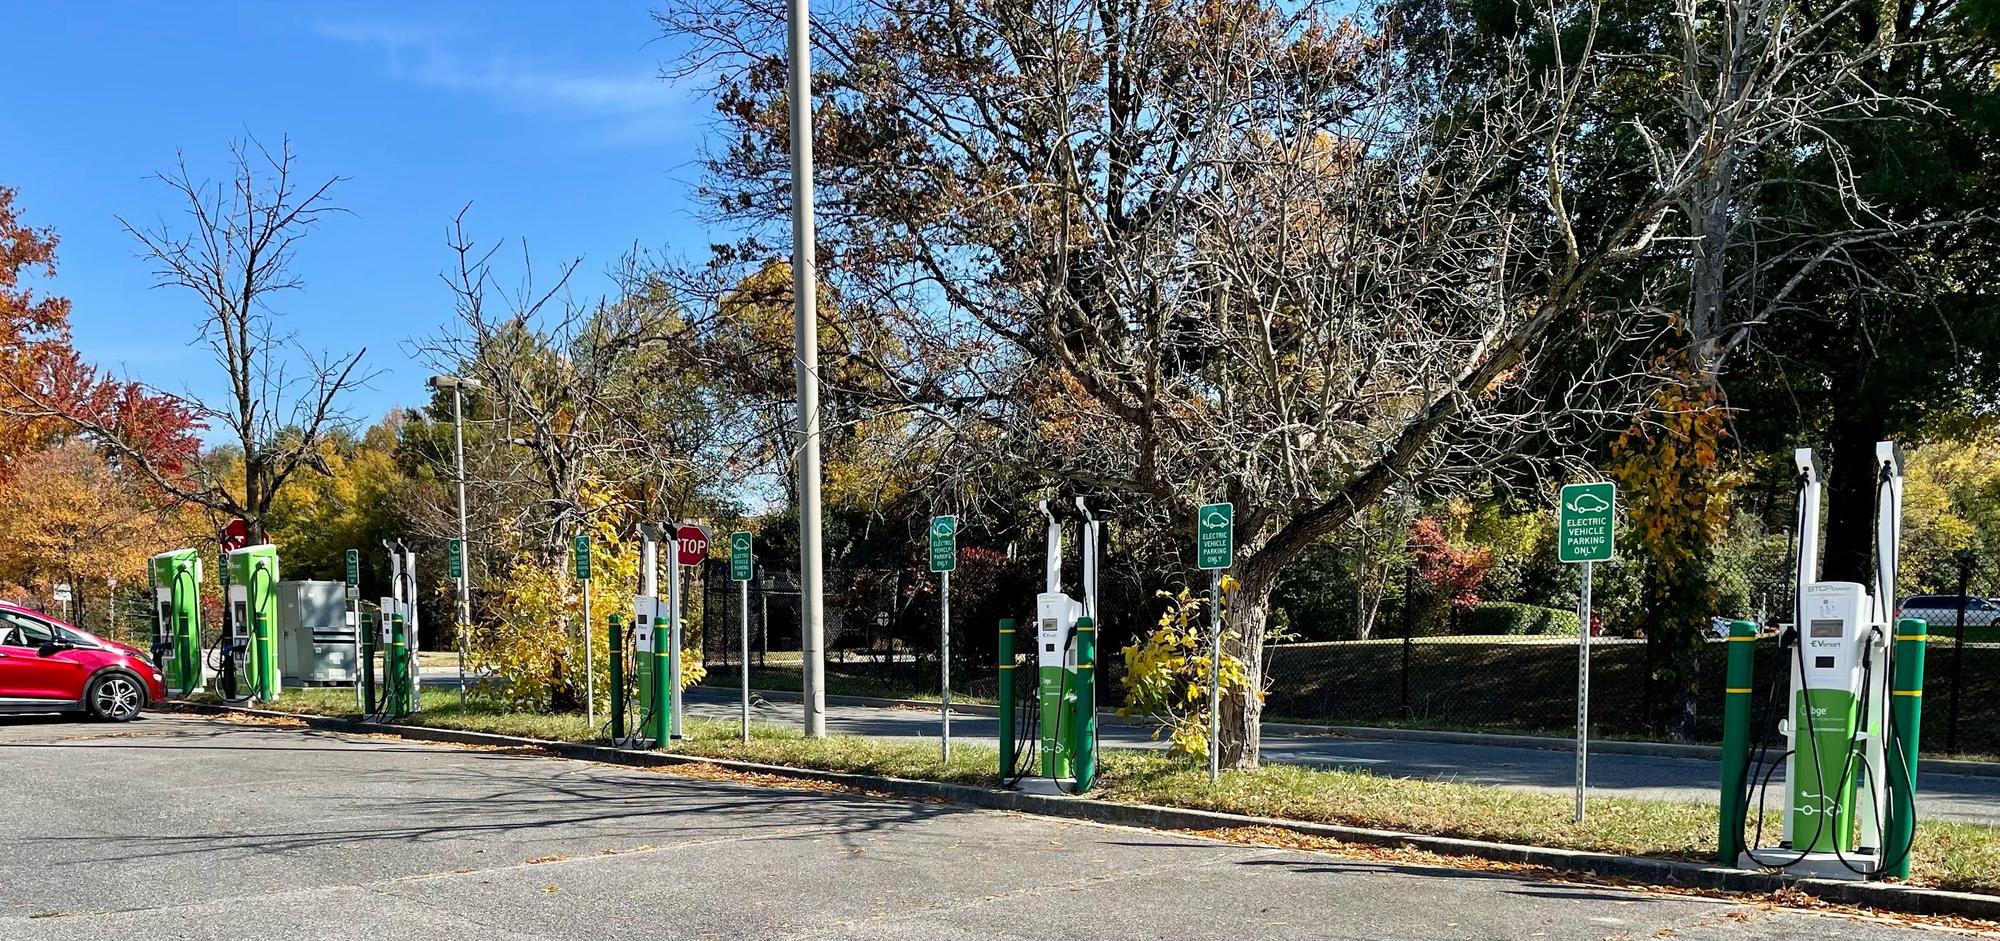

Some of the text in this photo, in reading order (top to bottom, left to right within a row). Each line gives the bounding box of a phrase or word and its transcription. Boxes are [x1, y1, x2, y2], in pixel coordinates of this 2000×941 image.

[1567, 517, 1607, 527] ELECTRIC
[1202, 532, 1227, 540] ELECTRIC
[1569, 527, 1605, 536] VEHICLE
[1568, 536, 1605, 545] PARKING
[1574, 546, 1597, 555] ONLY
[1810, 706, 1827, 717] bge
